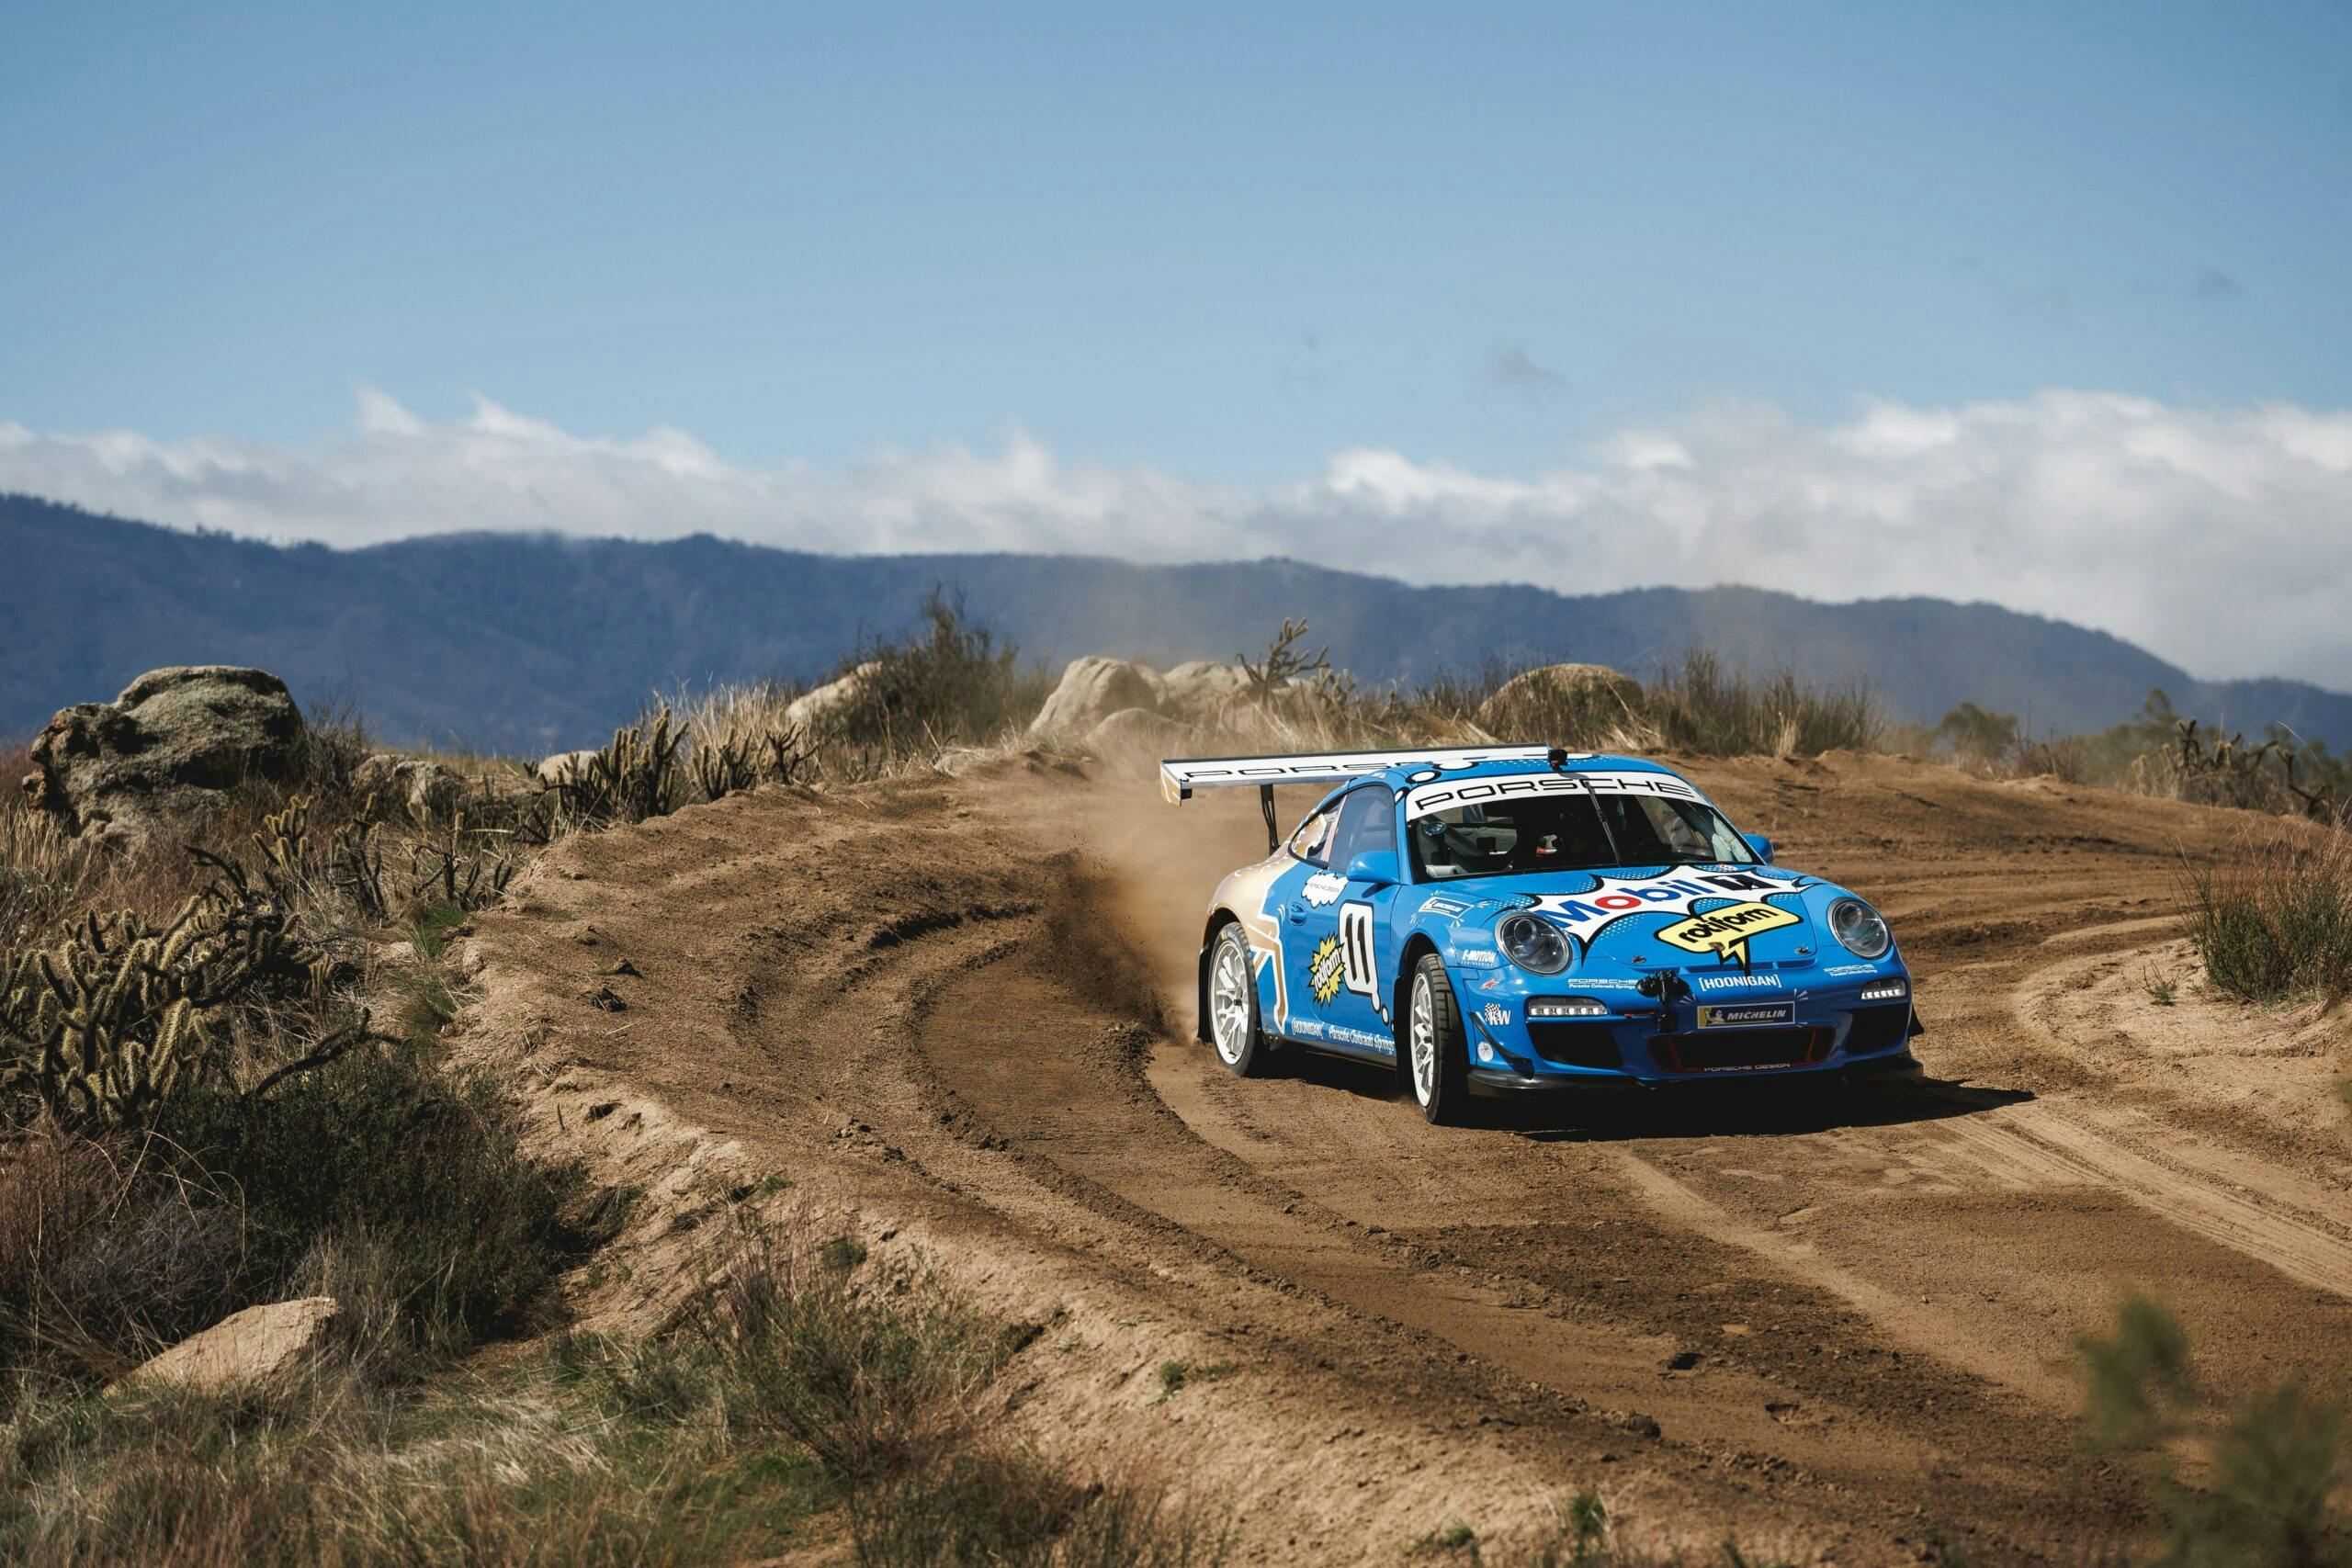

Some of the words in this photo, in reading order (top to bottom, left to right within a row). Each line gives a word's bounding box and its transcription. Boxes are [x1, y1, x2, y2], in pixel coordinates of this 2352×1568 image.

[1415, 779, 1694, 810] PORSCHE
[1533, 879, 1717, 929] Mobil
[1679, 908, 1779, 943] rotiform
[1344, 913, 1371, 985] 11
[1462, 950, 1496, 963] E-MOTION
[1698, 974, 1782, 992] [HOONIGAN]
[1487, 1010, 1511, 1026] KW
[1727, 1010, 1786, 1021] MICHELIN
[1329, 1024, 1350, 1043] Porsche
[1349, 1028, 1374, 1047] Colorado
[1374, 1034, 1396, 1055] Springs
[1754, 1062, 1791, 1070] DESIGN
